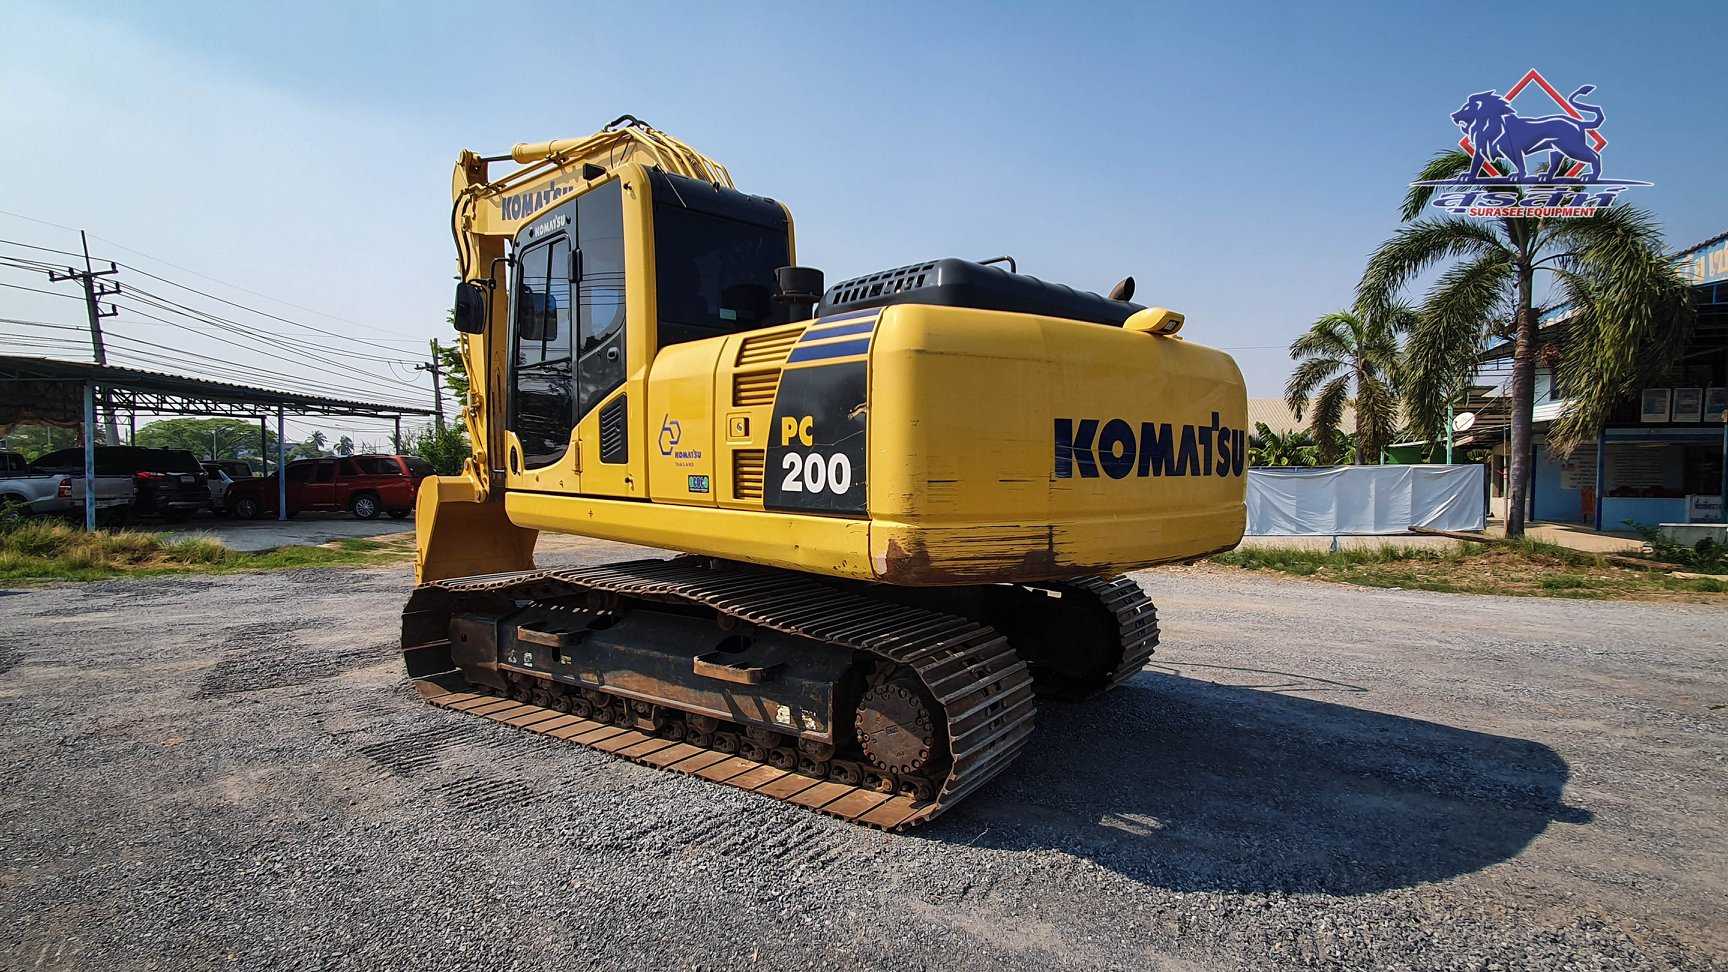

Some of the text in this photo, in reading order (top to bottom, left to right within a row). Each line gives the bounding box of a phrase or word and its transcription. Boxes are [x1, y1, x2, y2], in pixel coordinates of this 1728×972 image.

[501, 181, 574, 220] KOMAT
[535, 214, 566, 237] KOMATSU
[781, 415, 814, 447] PC
[1054, 411, 1245, 480] KOMATSU
[674, 449, 702, 459] KOMATSU
[781, 452, 852, 495] 200
